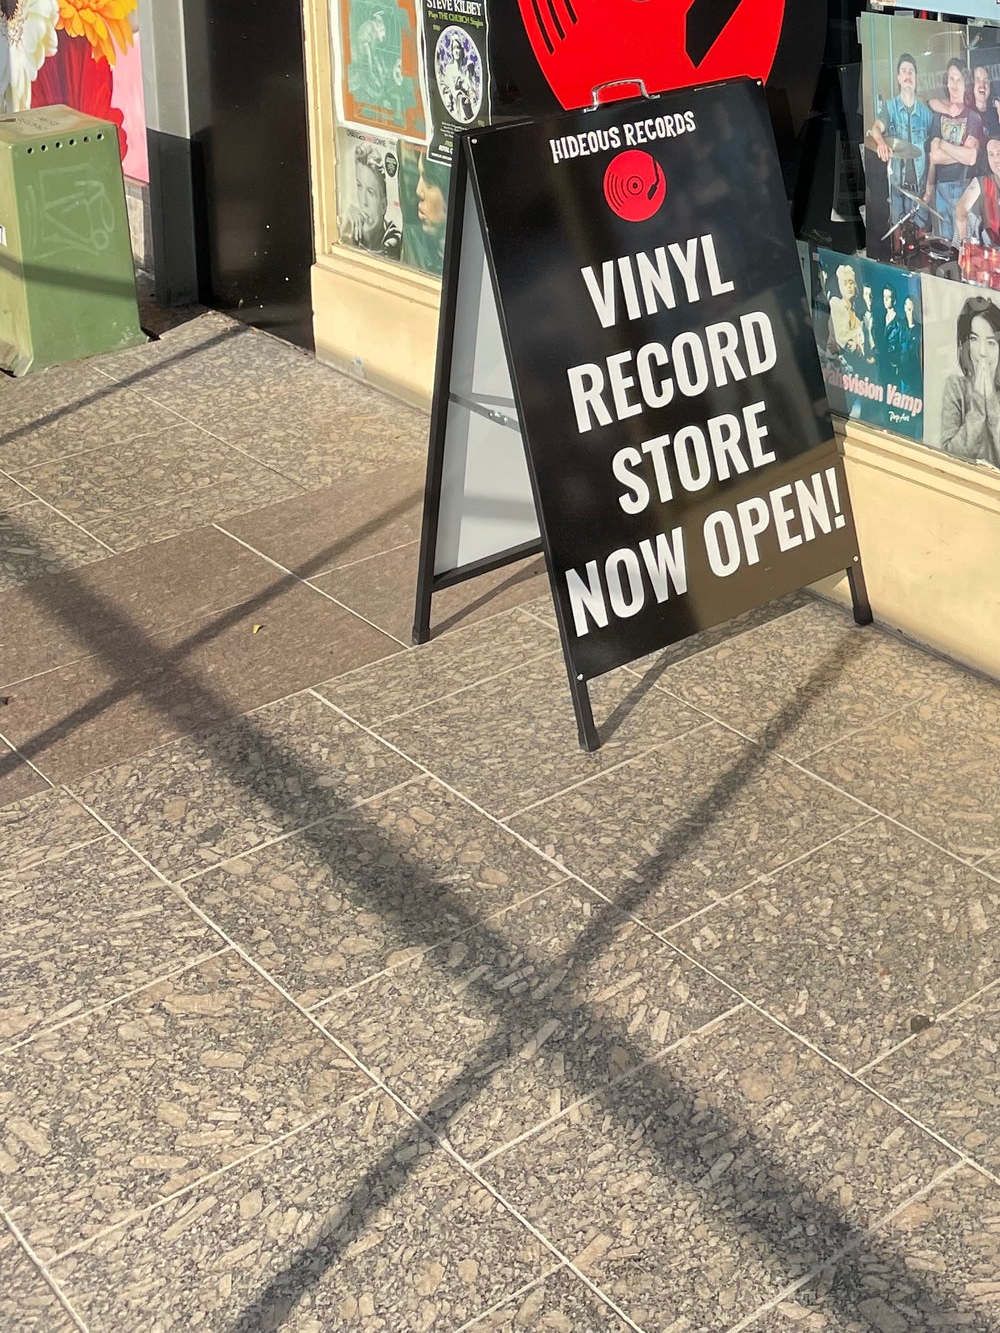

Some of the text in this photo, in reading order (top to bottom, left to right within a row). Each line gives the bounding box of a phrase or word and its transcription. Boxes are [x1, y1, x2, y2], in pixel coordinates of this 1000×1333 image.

[453, 0, 482, 16] KILBEY
[549, 111, 696, 164] HIDEOUS RECORDS
[580, 233, 735, 329] VINYL
[566, 310, 778, 433] RECORD
[886, 383, 923, 417] Vamp
[611, 401, 776, 515] STORE
[564, 467, 846, 638] NOW OPEN!
